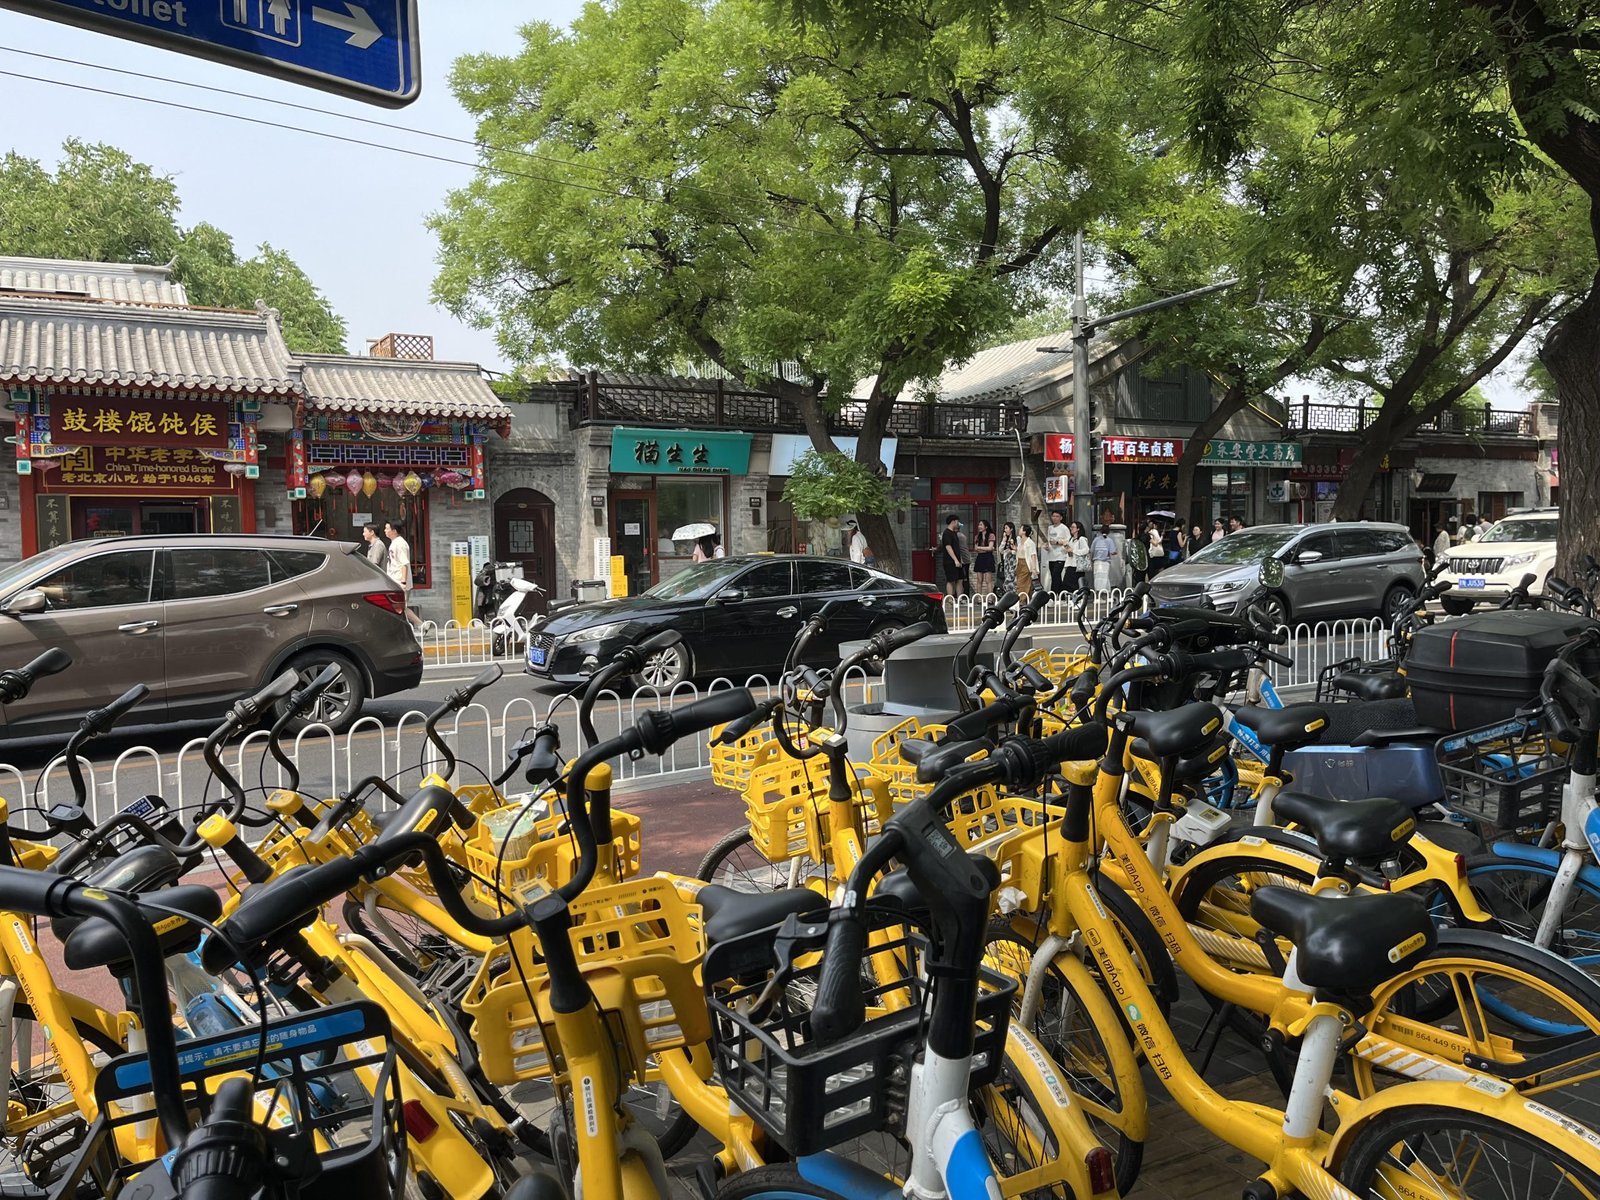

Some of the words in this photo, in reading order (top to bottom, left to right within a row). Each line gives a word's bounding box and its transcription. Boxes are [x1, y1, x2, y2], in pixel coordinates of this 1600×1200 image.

[95, 0, 187, 27] ilet
[61, 407, 219, 436] 鼓楼馄饨侯
[634, 439, 710, 465] 猫生生
[1059, 438, 1174, 456] 杨门框百年卤煮
[1217, 442, 1296, 461] 永安堂大药房
[105, 463, 131, 472] China
[132, 463, 190, 473] Time-honored
[191, 464, 216, 474] Brand
[62, 473, 139, 484] 老北京小吃
[142, 473, 215, 485] 始于1946年
[1119, 853, 1145, 894] 美团App
[1148, 905, 1167, 928] 微信
[1164, 932, 1182, 955] 扫码
[1096, 946, 1125, 995] 美团App
[1137, 1022, 1156, 1050] 微信
[1152, 1052, 1172, 1080] 扫码
[1415, 1031, 1431, 1041] 864
[1433, 1038, 1449, 1048] 449
[1398, 1184, 1416, 1199] 864
